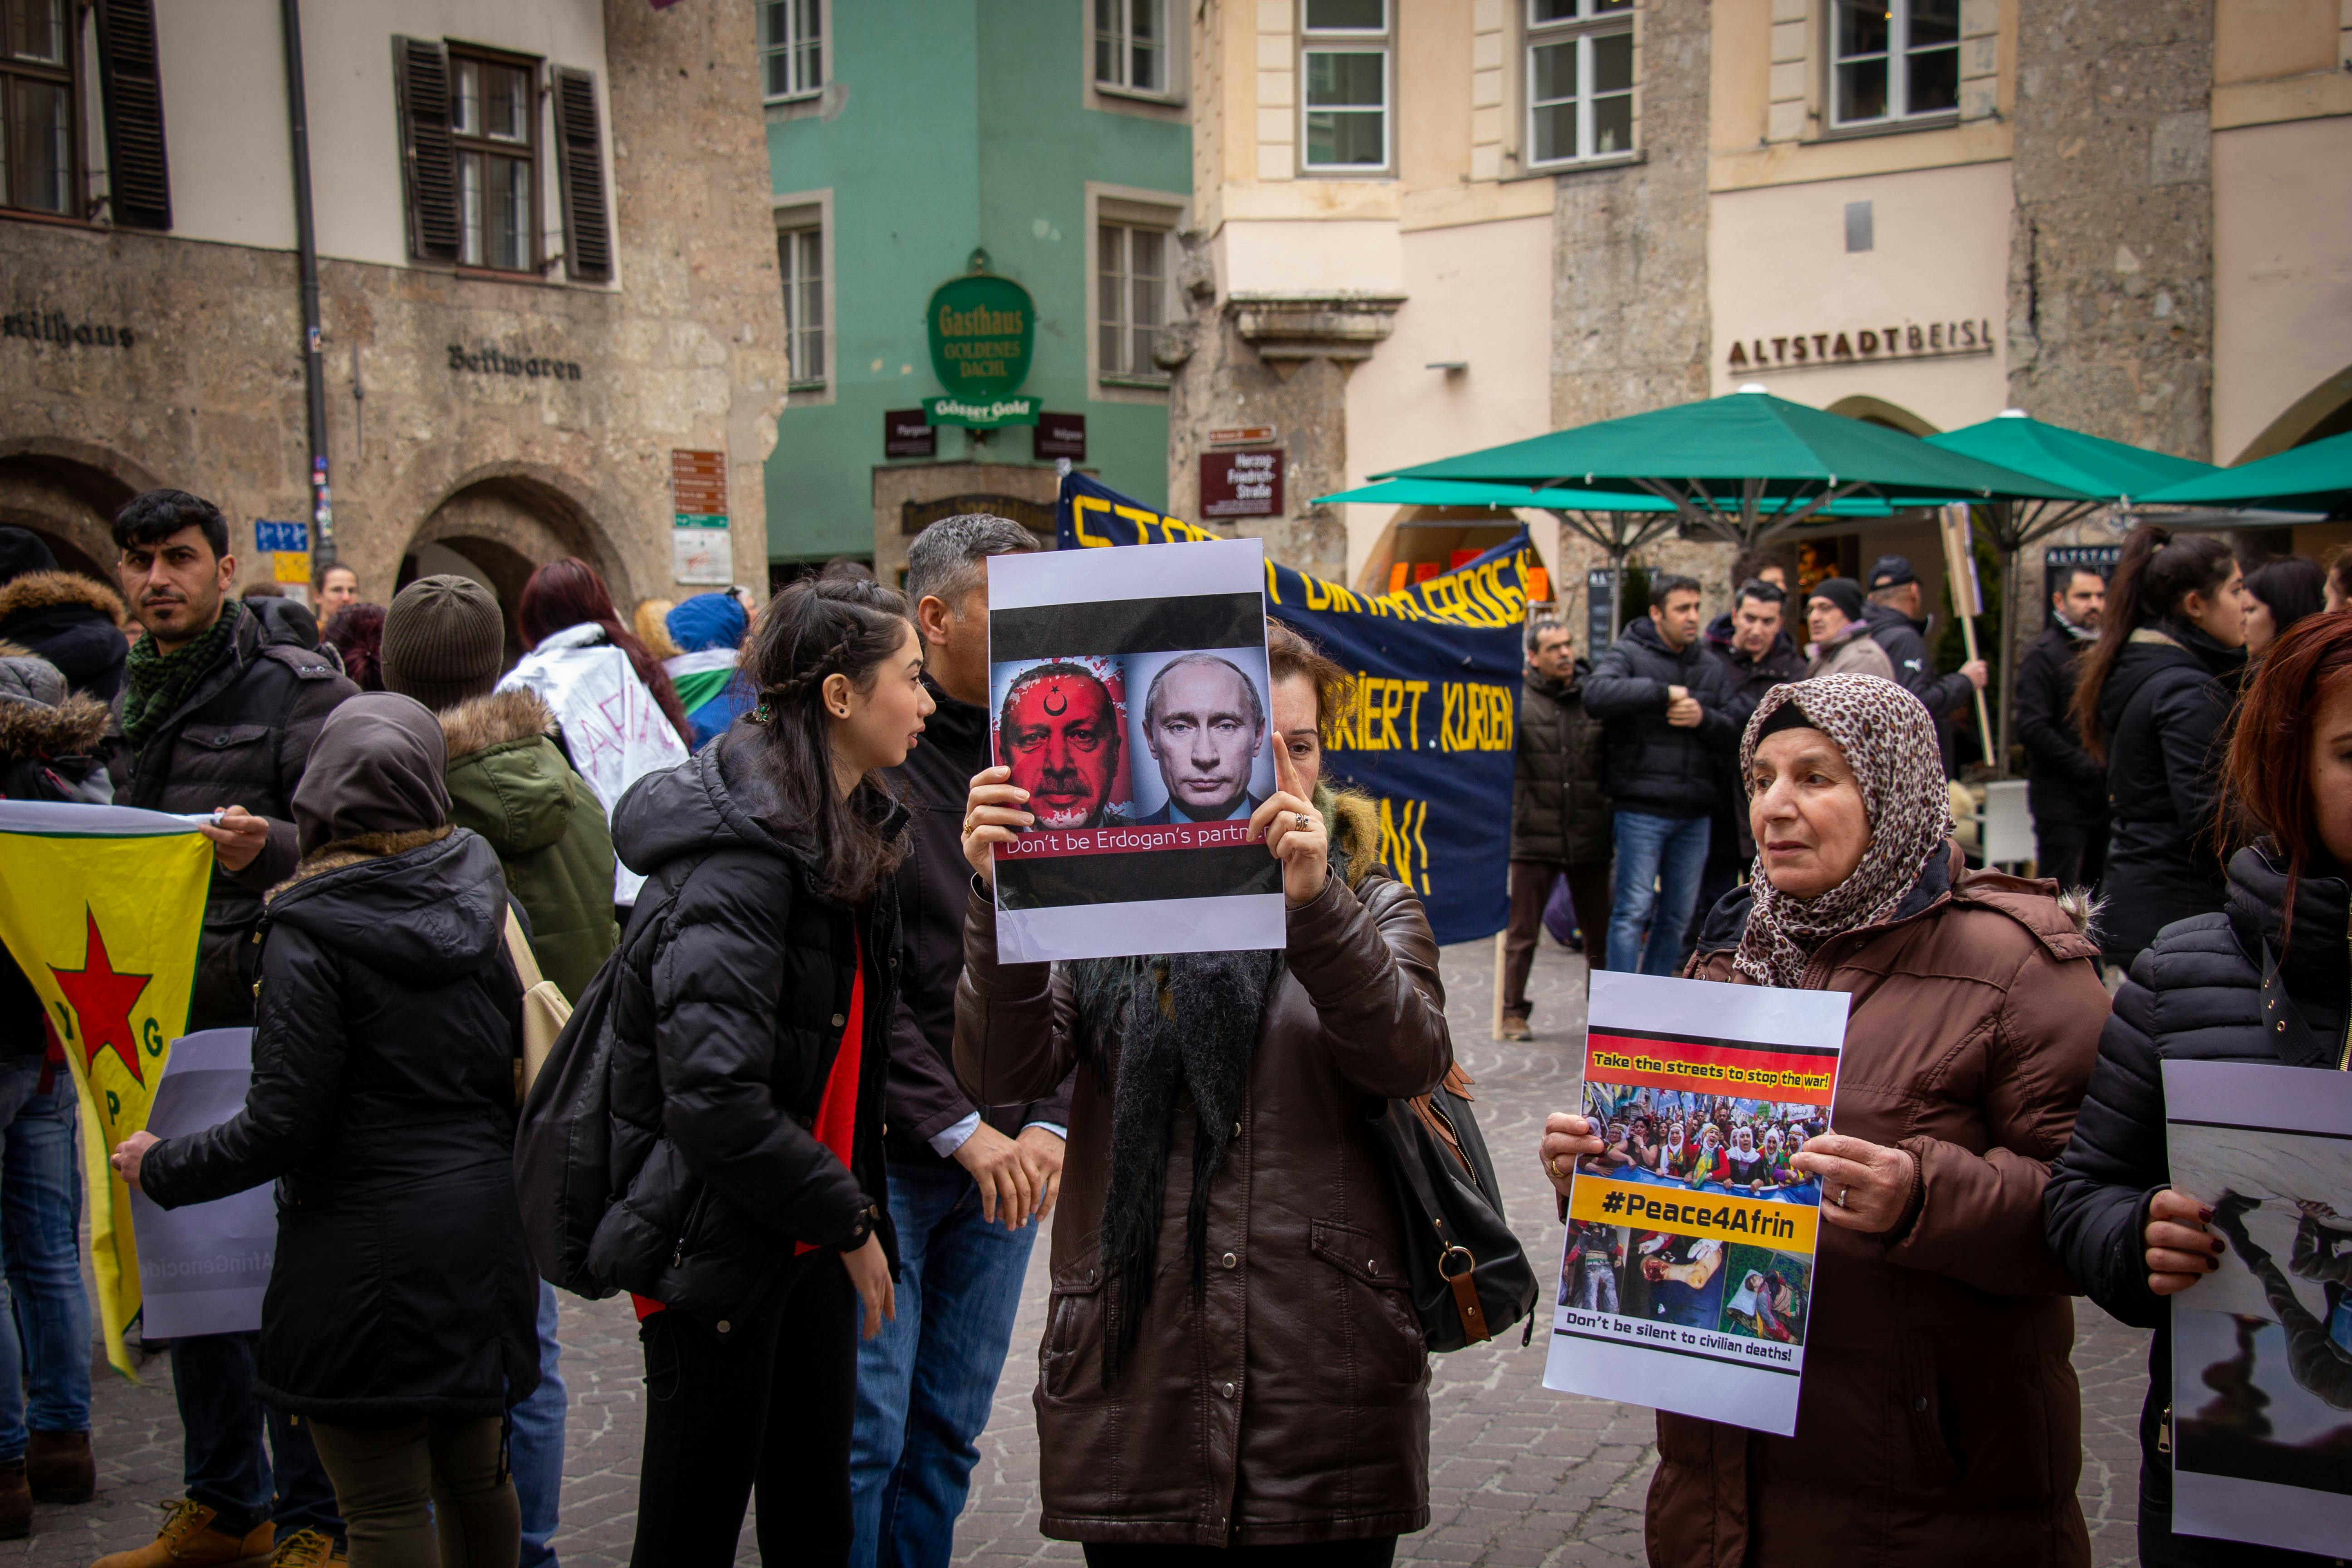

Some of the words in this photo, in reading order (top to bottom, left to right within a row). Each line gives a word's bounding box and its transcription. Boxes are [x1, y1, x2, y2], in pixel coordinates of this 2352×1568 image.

[939, 304, 1024, 338] Gasthaus
[944, 341, 1021, 359] GOLDENES
[1728, 318, 1993, 364] ALTSTADTBEISL
[446, 343, 581, 381] Bettwaren
[960, 360, 1008, 378] DACHL
[935, 399, 990, 418] Gösser
[991, 400, 1030, 416] Gold
[2047, 549, 2122, 564] ALTSTAD
[1440, 681, 1514, 753] KURDEN
[1006, 834, 1060, 854] Don't
[1066, 833, 1090, 850] be
[1097, 827, 1191, 850] Erdogan's
[1197, 824, 1271, 847] partnr
[1593, 1052, 1630, 1068] Take
[1634, 1056, 1662, 1072] the
[1666, 1061, 1724, 1078] streets
[1728, 1067, 1744, 1080] to
[1747, 1070, 1778, 1086] stop
[1781, 1072, 1801, 1086] the
[1803, 1074, 1829, 1088] war!
[1602, 1191, 1794, 1239] #Peace4Afrin
[1566, 1312, 1609, 1330] Don’t
[1613, 1318, 1632, 1333] be
[1636, 1323, 1676, 1341] silent
[1681, 1331, 1695, 1344] to
[1700, 1334, 1742, 1353] civilian
[1745, 1342, 1792, 1362] deaths!
